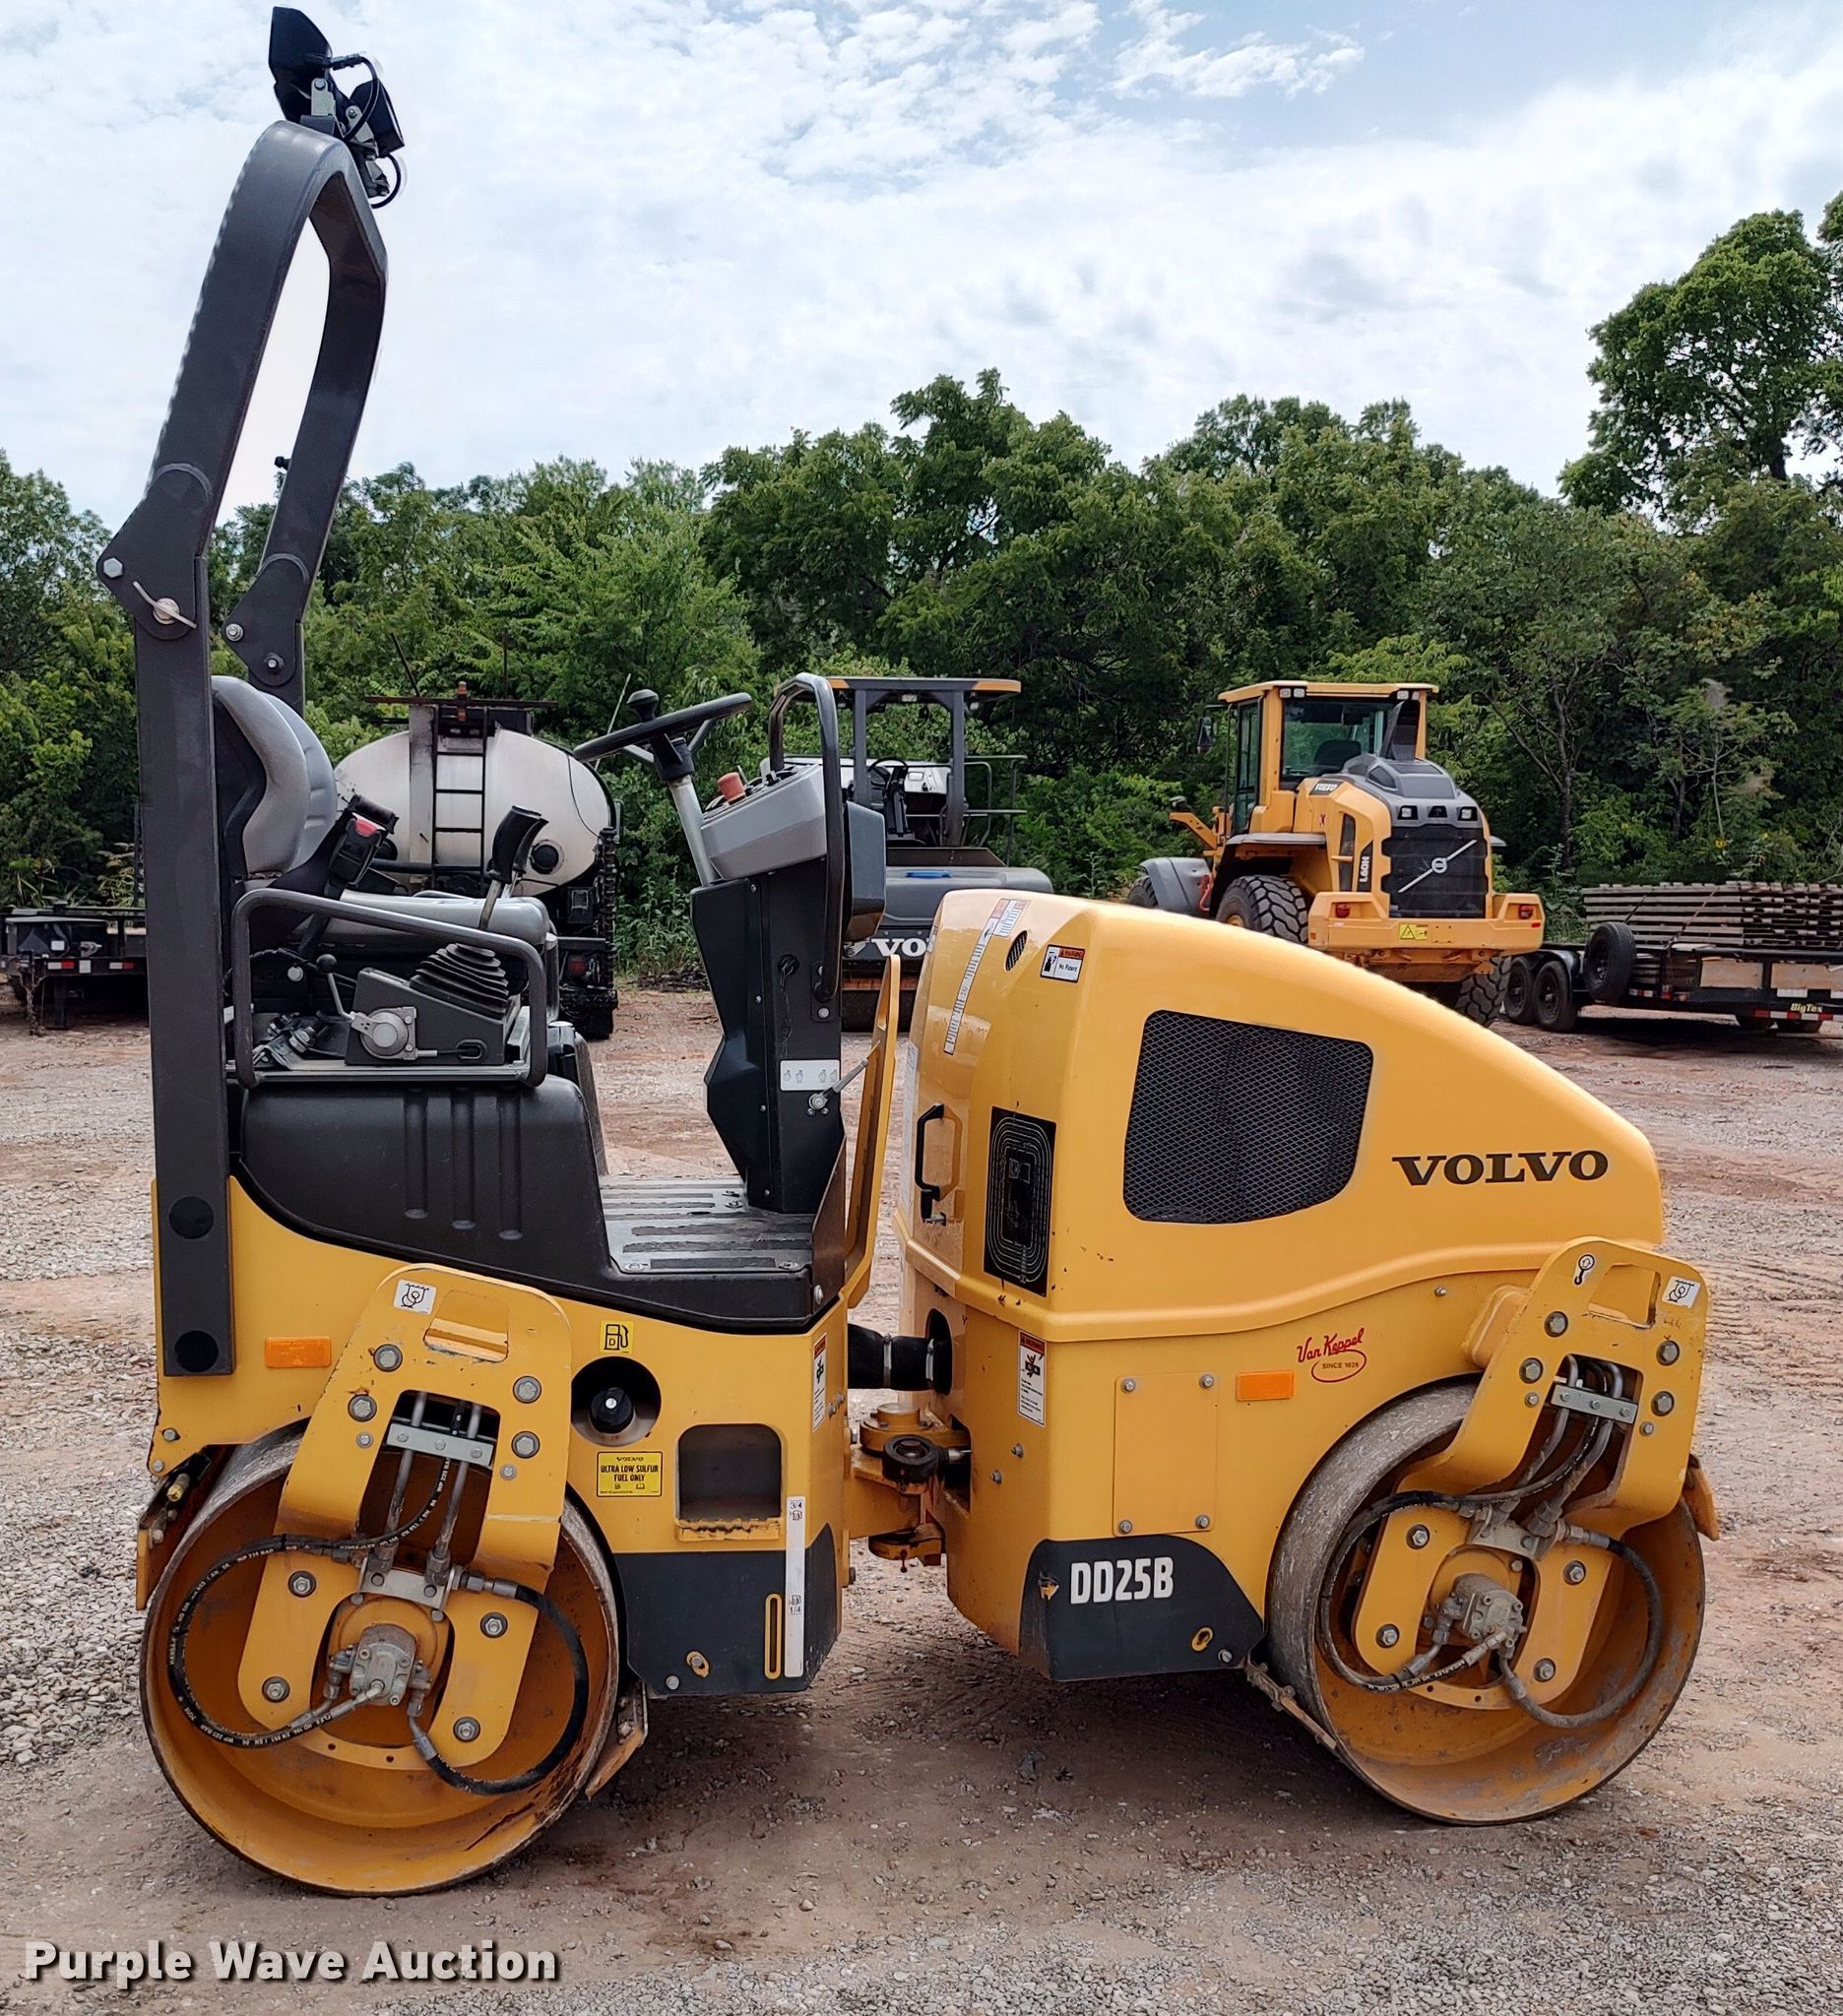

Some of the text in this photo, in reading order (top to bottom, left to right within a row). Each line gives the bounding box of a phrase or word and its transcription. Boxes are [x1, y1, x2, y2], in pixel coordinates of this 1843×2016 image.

[1359, 855, 1370, 883] L60H
[871, 937, 929, 957] VO
[1391, 1150, 1609, 1186] VOLVO
[608, 1338, 616, 1347] D
[1296, 1327, 1365, 1363] Van Keppel
[601, 1464, 659, 1474] ULTRA LOW SULFUR
[1070, 1556, 1175, 1605] DD25B
